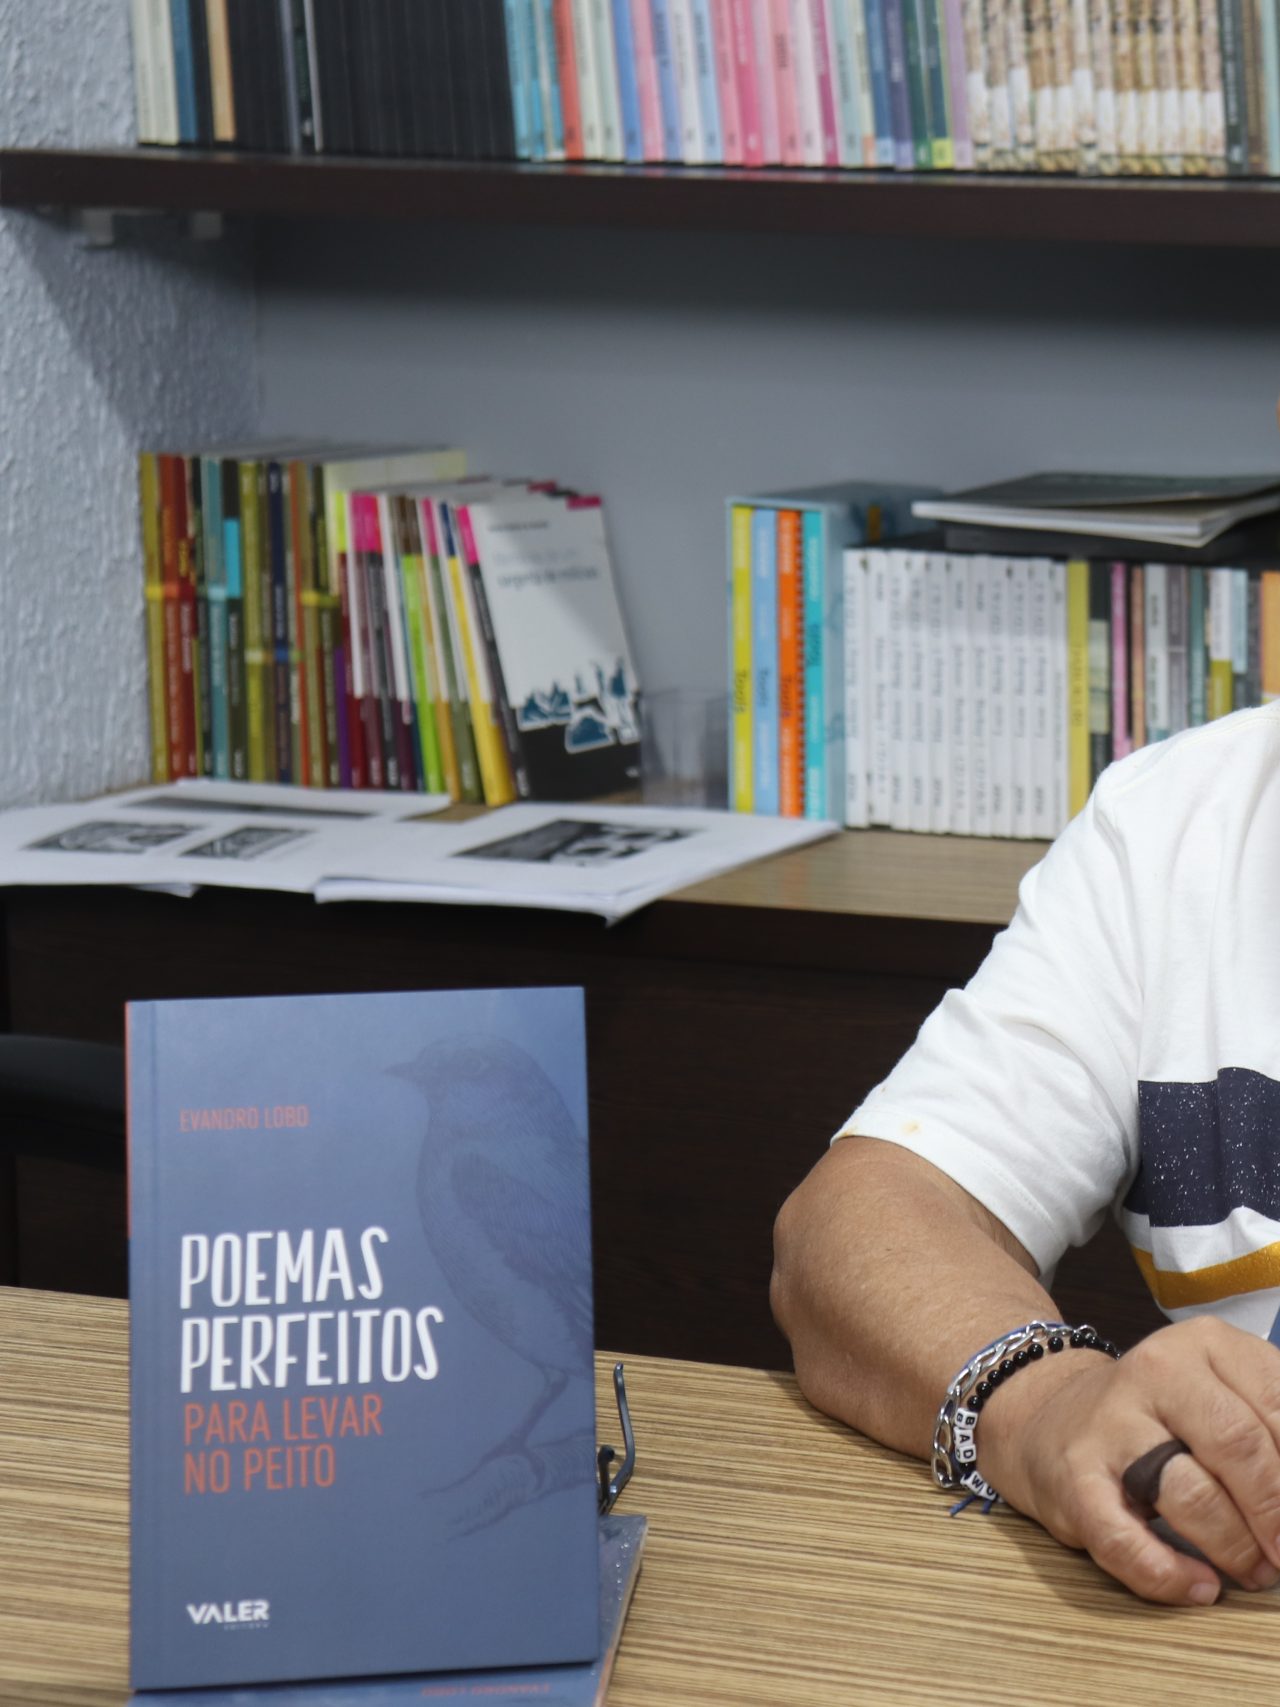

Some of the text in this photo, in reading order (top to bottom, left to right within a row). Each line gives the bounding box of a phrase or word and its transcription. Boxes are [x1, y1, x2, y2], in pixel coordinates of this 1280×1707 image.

[179, 1104, 309, 1133] EVANDRO LOBO
[179, 1225, 389, 1310] POEMAS
[180, 1306, 445, 1394] PERFEITOS
[183, 1392, 385, 1446] PARA LEVAR
[957, 1412, 976, 1460] BAD
[183, 1442, 336, 1495] NO PEITO
[186, 1599, 270, 1624] VALER
